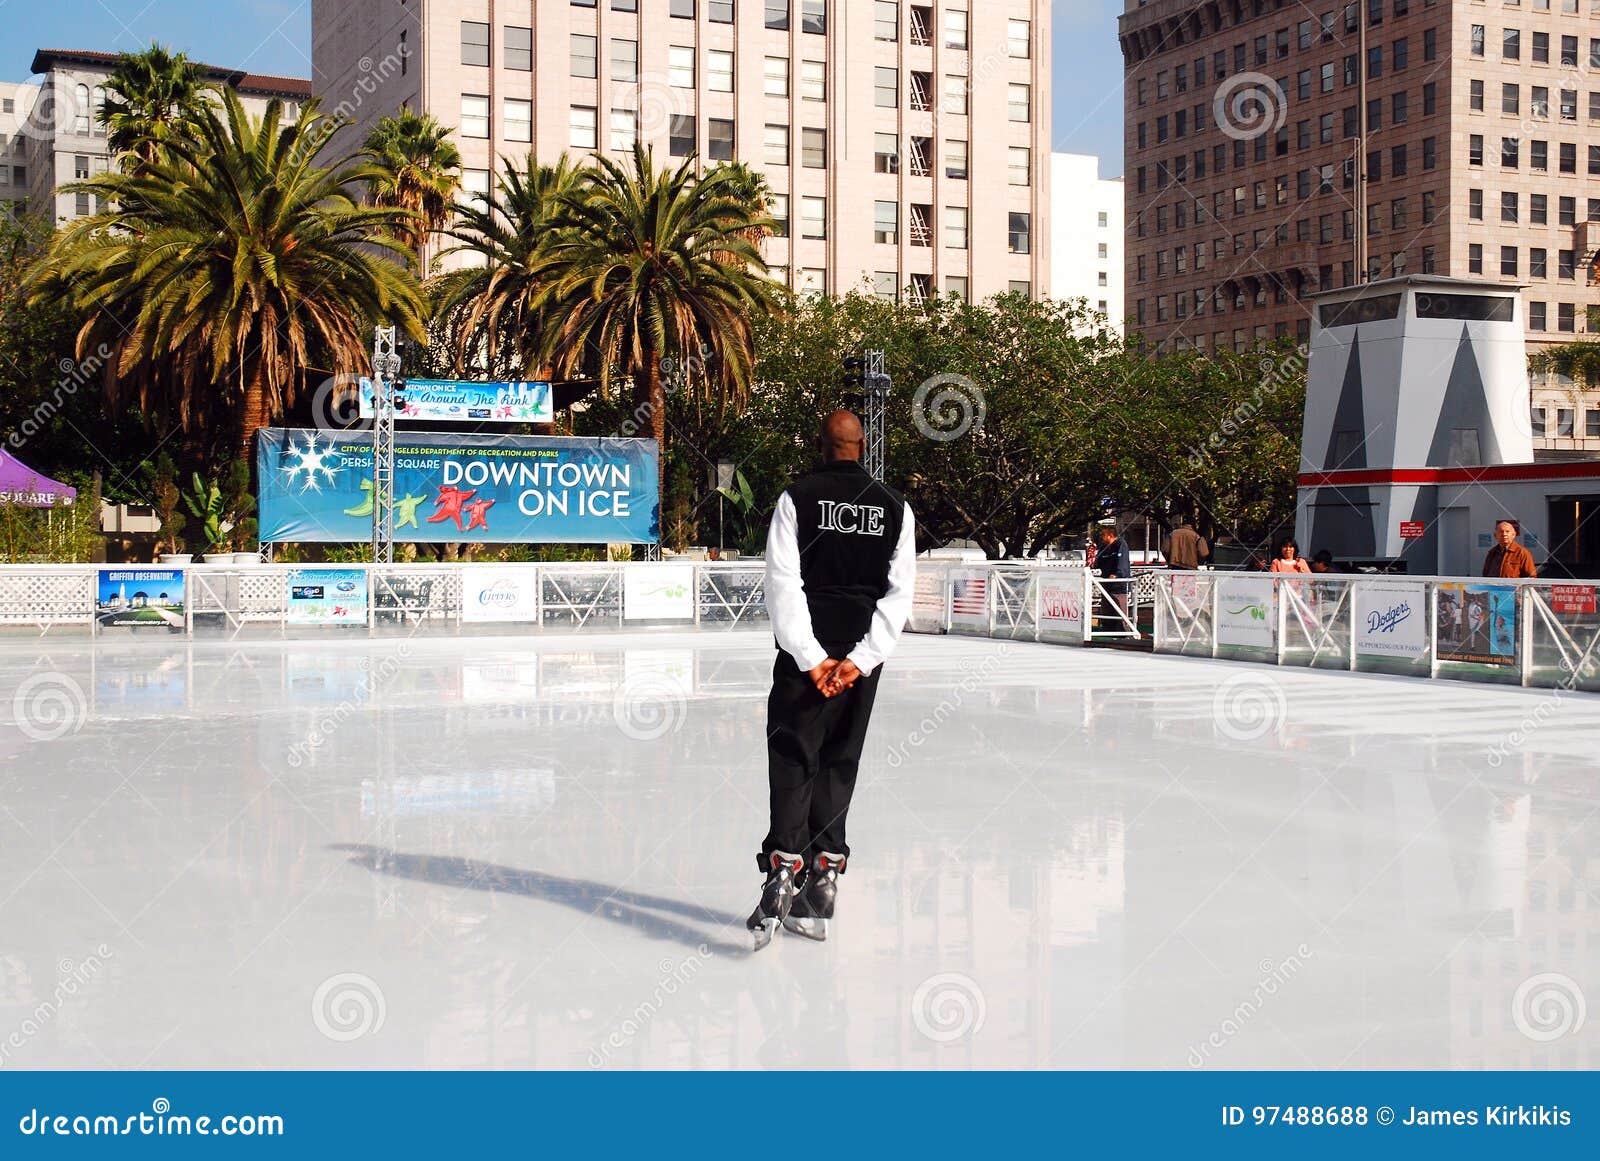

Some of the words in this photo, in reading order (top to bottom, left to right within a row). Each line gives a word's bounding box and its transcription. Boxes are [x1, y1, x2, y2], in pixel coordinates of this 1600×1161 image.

[421, 392, 467, 404] Around
[473, 393, 496, 406] The
[500, 394, 529, 405] Rink
[341, 445, 358, 453] CITY
[393, 447, 420, 455] NGELES
[421, 448, 466, 456] DEPARTMENT
[478, 449, 521, 457] RECREATION
[538, 450, 559, 458] PARKS
[397, 459, 440, 470] SQUARE
[443, 461, 630, 487] DOWNTOWN
[518, 490, 568, 516] ON
[578, 490, 631, 517] ICE
[818, 500, 885, 537] ICE
[1042, 600, 1079, 618] NEWS
[1367, 600, 1411, 633] Dodgers
